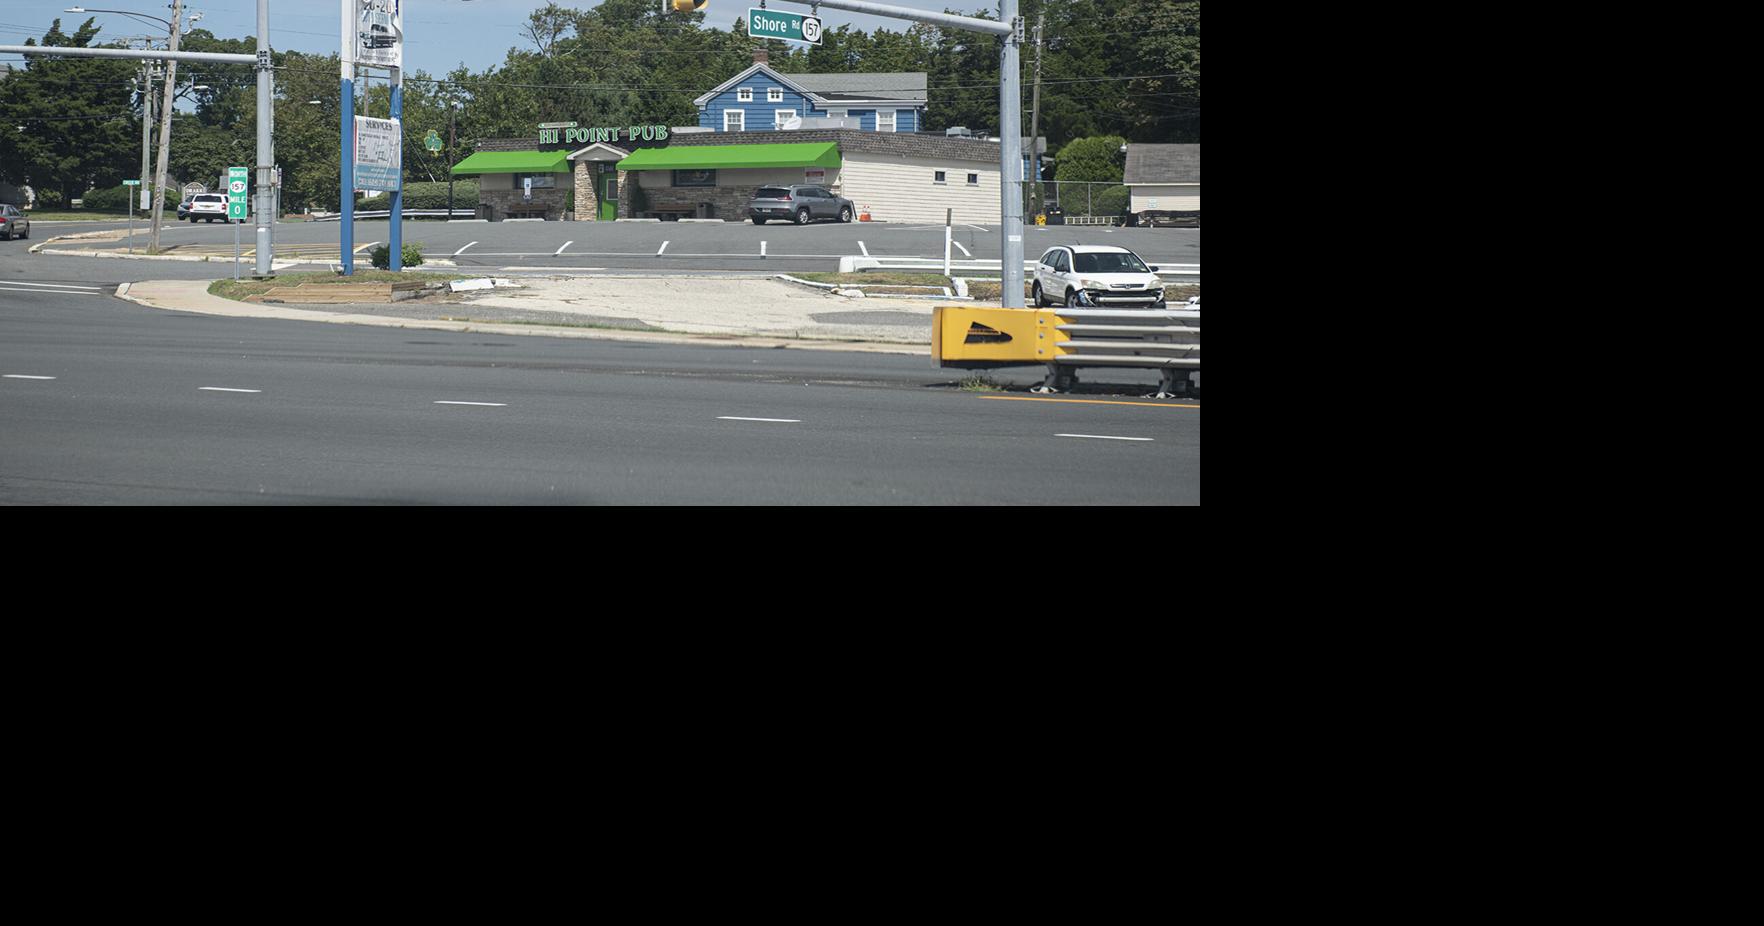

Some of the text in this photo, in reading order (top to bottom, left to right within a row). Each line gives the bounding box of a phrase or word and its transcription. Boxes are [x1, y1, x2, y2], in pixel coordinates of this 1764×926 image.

[753, 15, 801, 32] Shore Rd
[805, 22, 819, 37] 157
[365, 120, 393, 131] SERVICES
[539, 124, 668, 144] HI POINT PUB
[231, 183, 245, 191] 157
[234, 205, 241, 215] 0
